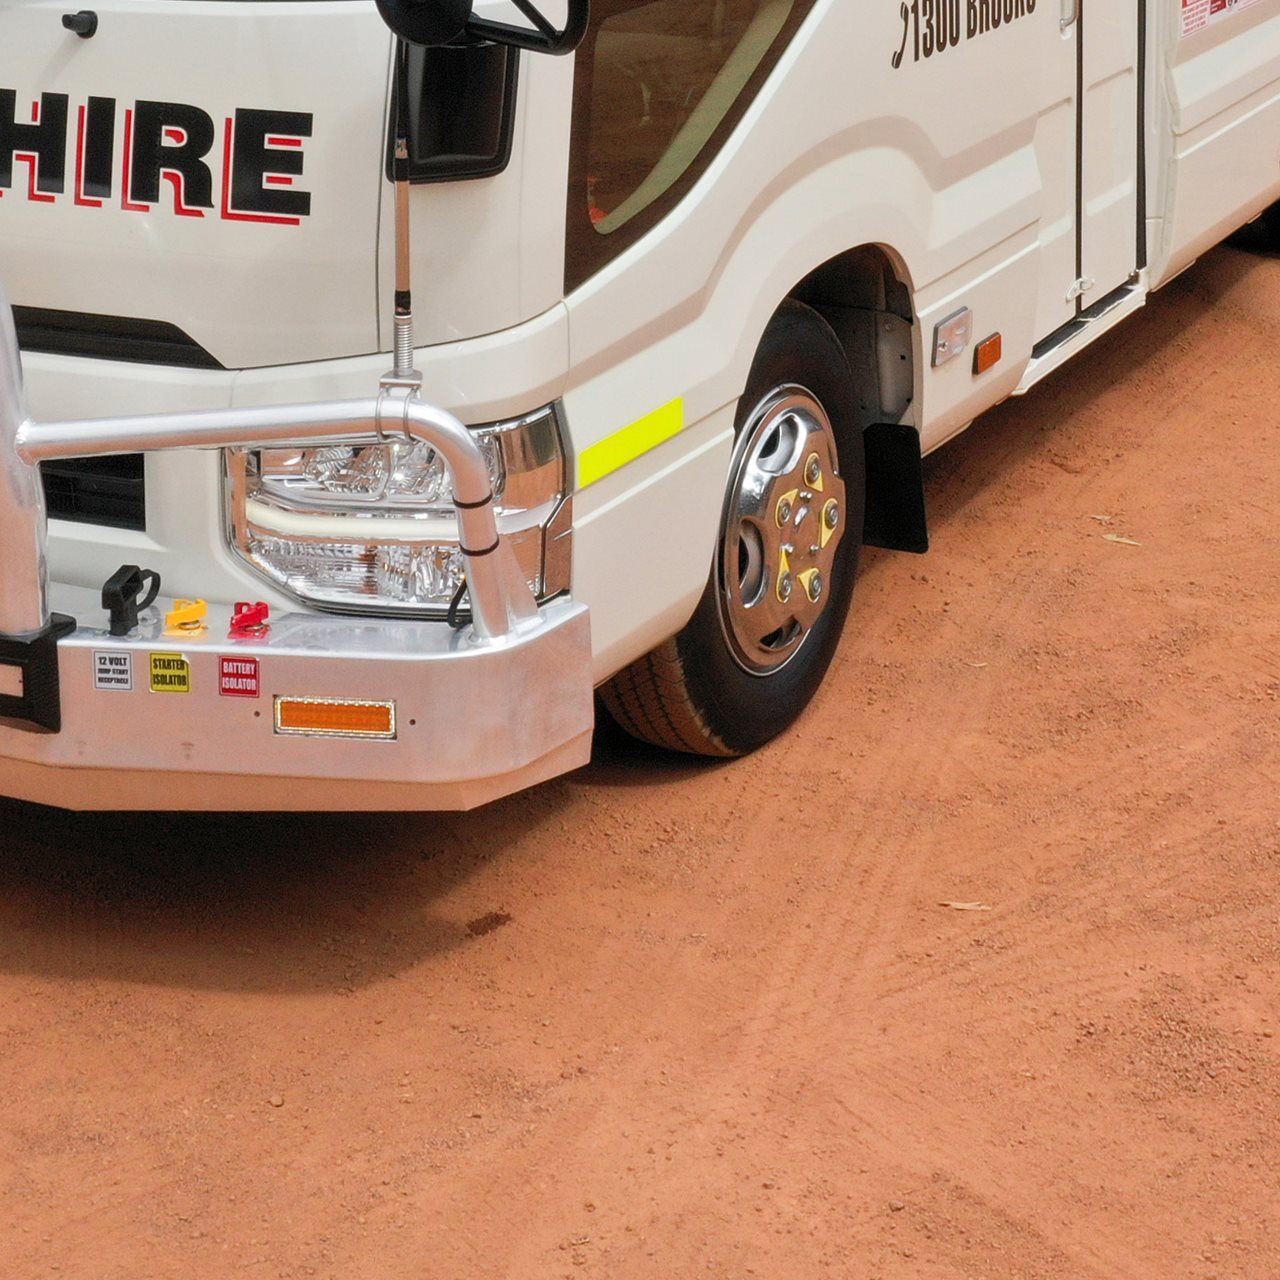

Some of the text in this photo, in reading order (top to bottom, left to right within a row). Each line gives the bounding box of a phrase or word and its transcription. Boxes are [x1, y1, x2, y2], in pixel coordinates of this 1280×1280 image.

[98, 656, 127, 667] 12 VOLT
[152, 658, 186, 671] STARTER
[223, 661, 256, 675] BATTERY
[152, 673, 187, 687] ISOLATOR
[222, 676, 257, 691] ISOLATOR
